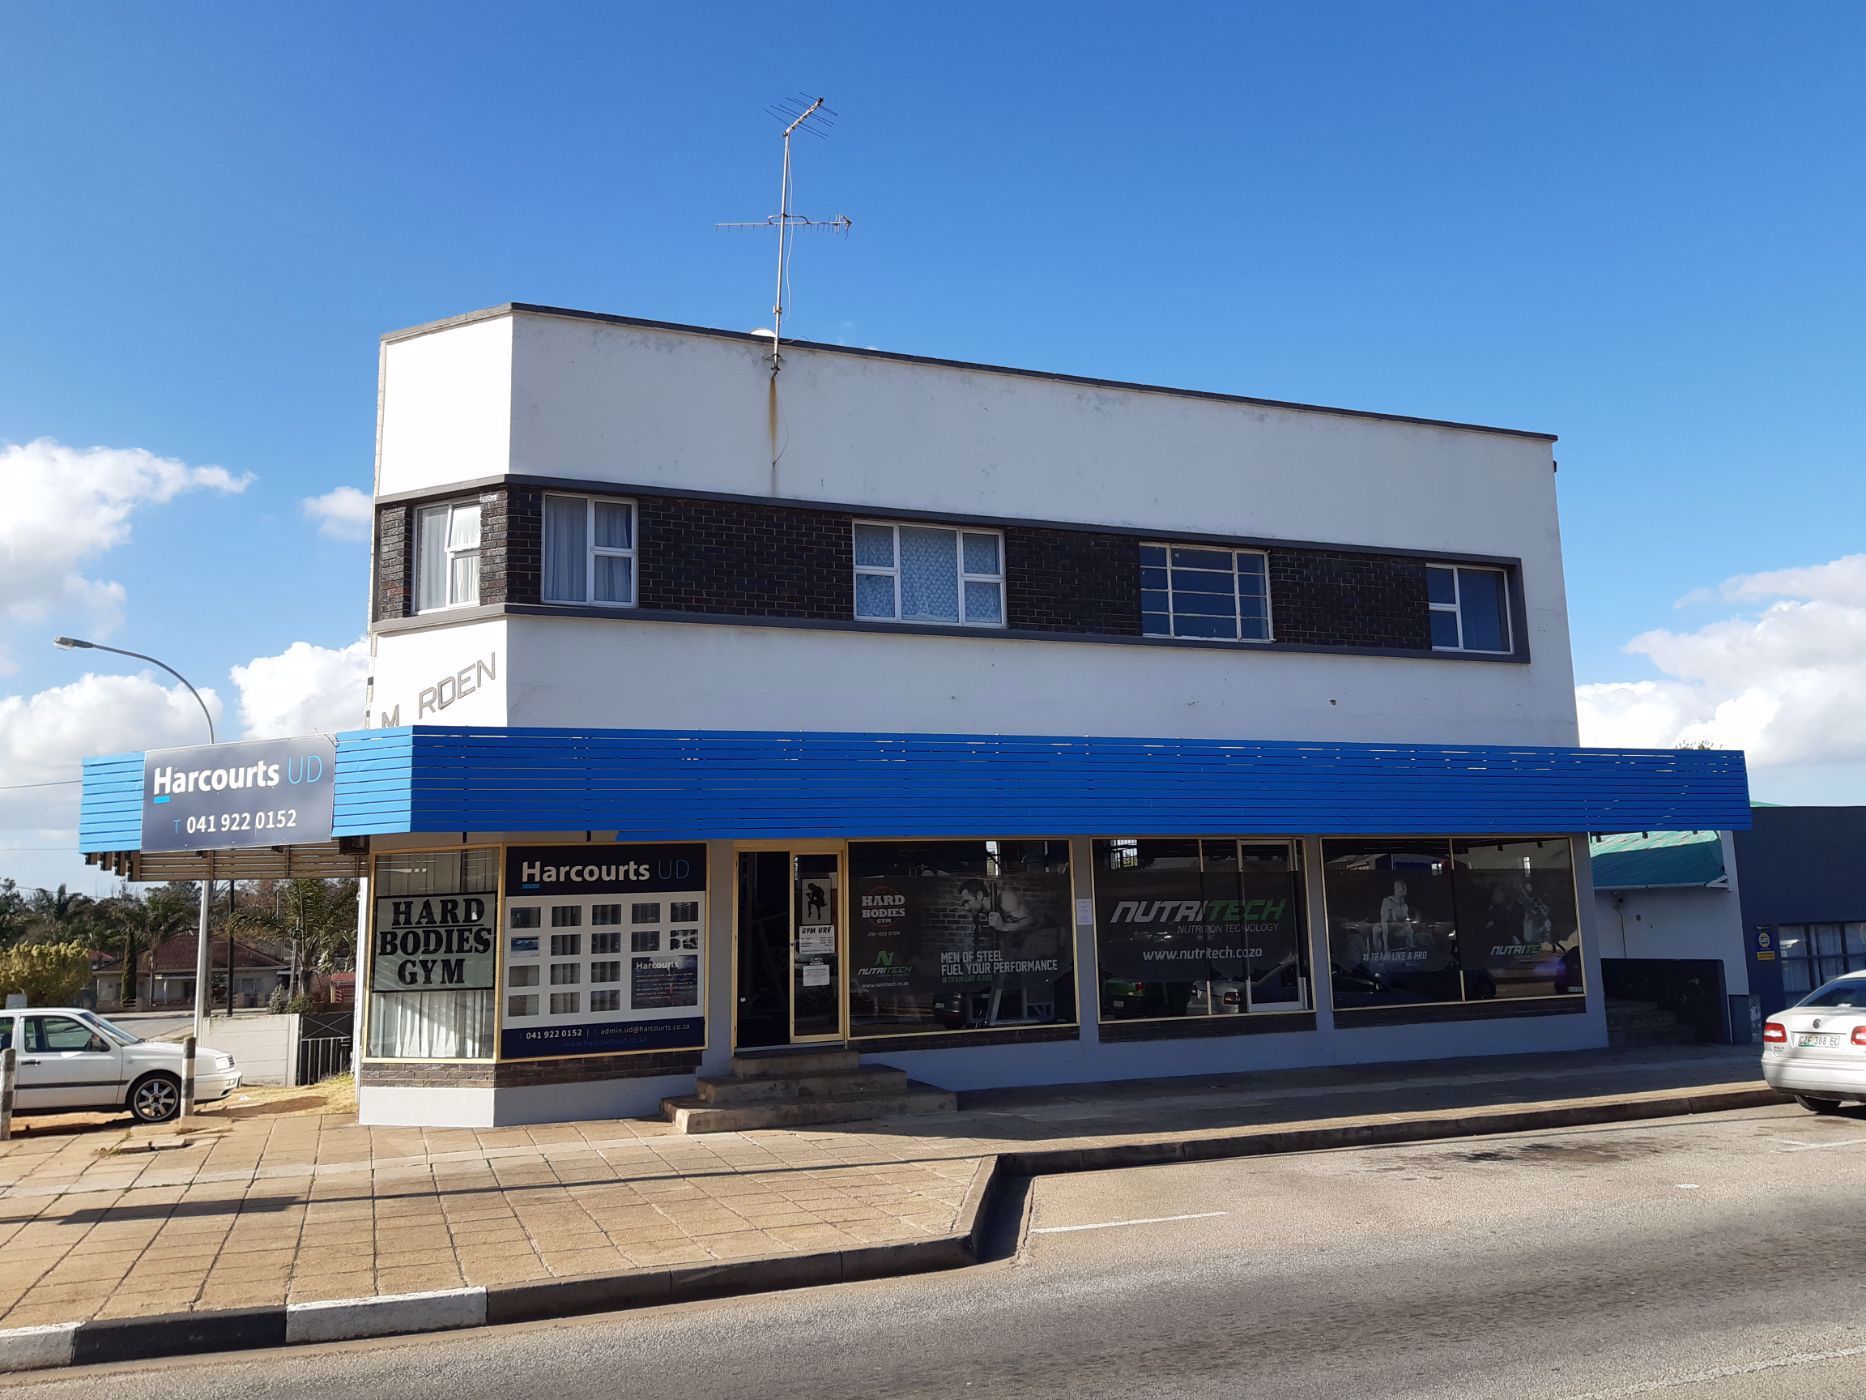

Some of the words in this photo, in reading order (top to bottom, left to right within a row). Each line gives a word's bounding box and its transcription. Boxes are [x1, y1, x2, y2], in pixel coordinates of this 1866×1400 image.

[153, 759, 280, 796] Harcourts
[287, 754, 323, 786] UD
[173, 818, 180, 835] T
[187, 815, 216, 835] 041
[221, 812, 250, 833] 922
[254, 809, 297, 831] 0152
[521, 860, 650, 883] Harcourts
[658, 859, 690, 880] UD
[862, 895, 905, 907] HARD
[392, 898, 485, 927] HARD
[862, 908, 906, 919] BODIES
[1110, 898, 1287, 923] NUTRITECH
[1177, 925, 1222, 935] NUTRITION
[379, 928, 492, 956] BODIES
[940, 952, 960, 964] MEN
[962, 951, 975, 963] OF
[976, 950, 1004, 962] STEEL
[1392, 951, 1406, 961] LIKE
[1414, 950, 1428, 960] PRO
[398, 958, 465, 986] GYM
[635, 960, 679, 970] Harcourts
[857, 966, 912, 976] NUTRITECH
[941, 964, 963, 976] FUEL
[966, 962, 991, 975] YOUR
[993, 959, 1059, 973] PERFORMANCE
[525, 1031, 542, 1040] 041
[543, 1030, 560, 1039] 922
[561, 1029, 583, 1038] 0152
